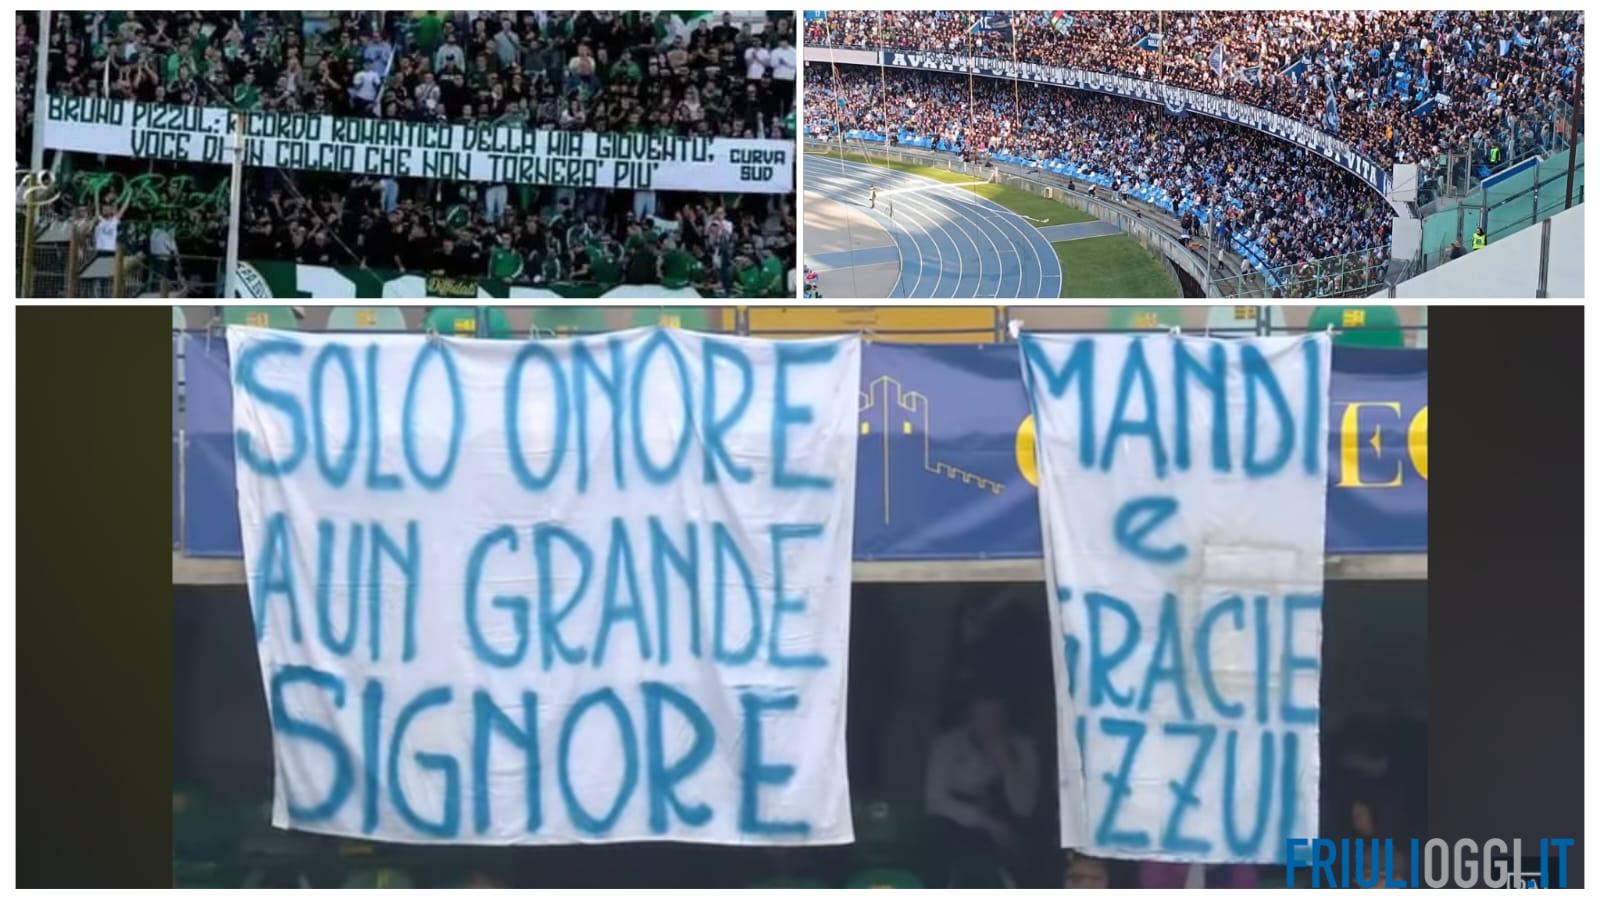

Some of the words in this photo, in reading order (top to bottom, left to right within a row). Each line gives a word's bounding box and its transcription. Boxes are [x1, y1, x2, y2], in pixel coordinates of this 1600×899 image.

[48, 96, 124, 125] BRUNO
[132, 101, 220, 133] PIZZUL:
[332, 116, 453, 149] ROMANTICO
[462, 124, 536, 155] DELLA
[547, 130, 583, 158] MIA
[131, 129, 190, 160] VOCE
[202, 135, 223, 163] DI
[276, 140, 354, 172] CALCIO
[365, 146, 412, 176] CHE
[423, 150, 471, 179] NON
[614, 161, 659, 189] PIU'
[730, 148, 786, 166] CURVA
[740, 166, 773, 182] SUD
[235, 336, 466, 492] SOLO
[505, 326, 839, 494] ONORE
[1019, 334, 1320, 481] MANDI
[1113, 495, 1189, 566] e
[464, 515, 829, 671] GRANDE
[270, 664, 811, 839] SIGNORE
